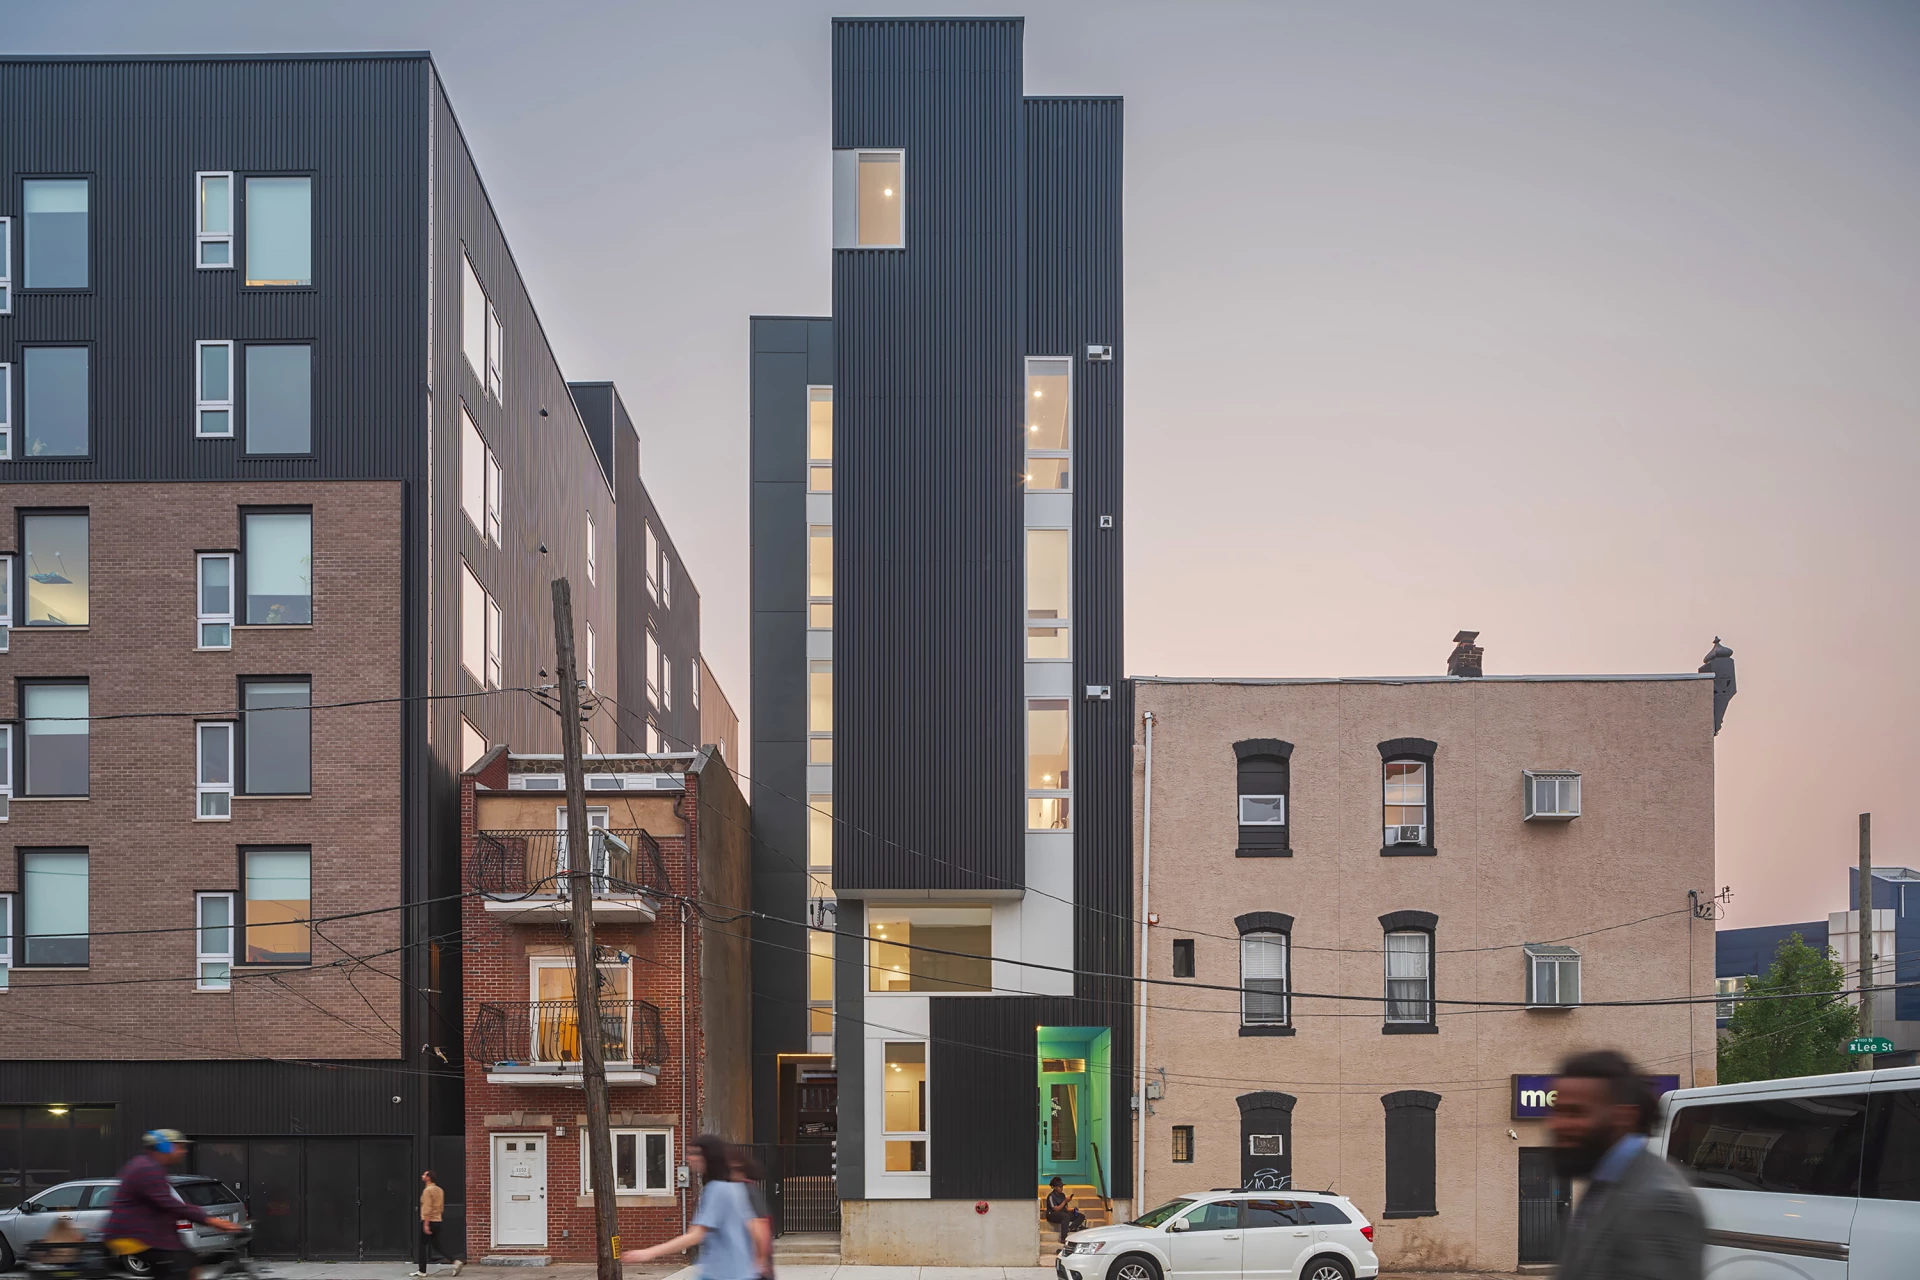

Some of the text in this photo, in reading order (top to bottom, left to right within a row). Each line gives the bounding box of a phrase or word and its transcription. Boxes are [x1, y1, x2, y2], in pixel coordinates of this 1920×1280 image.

[1857, 1043, 1892, 1051] Lee St
[1520, 1090, 1559, 1107] me
